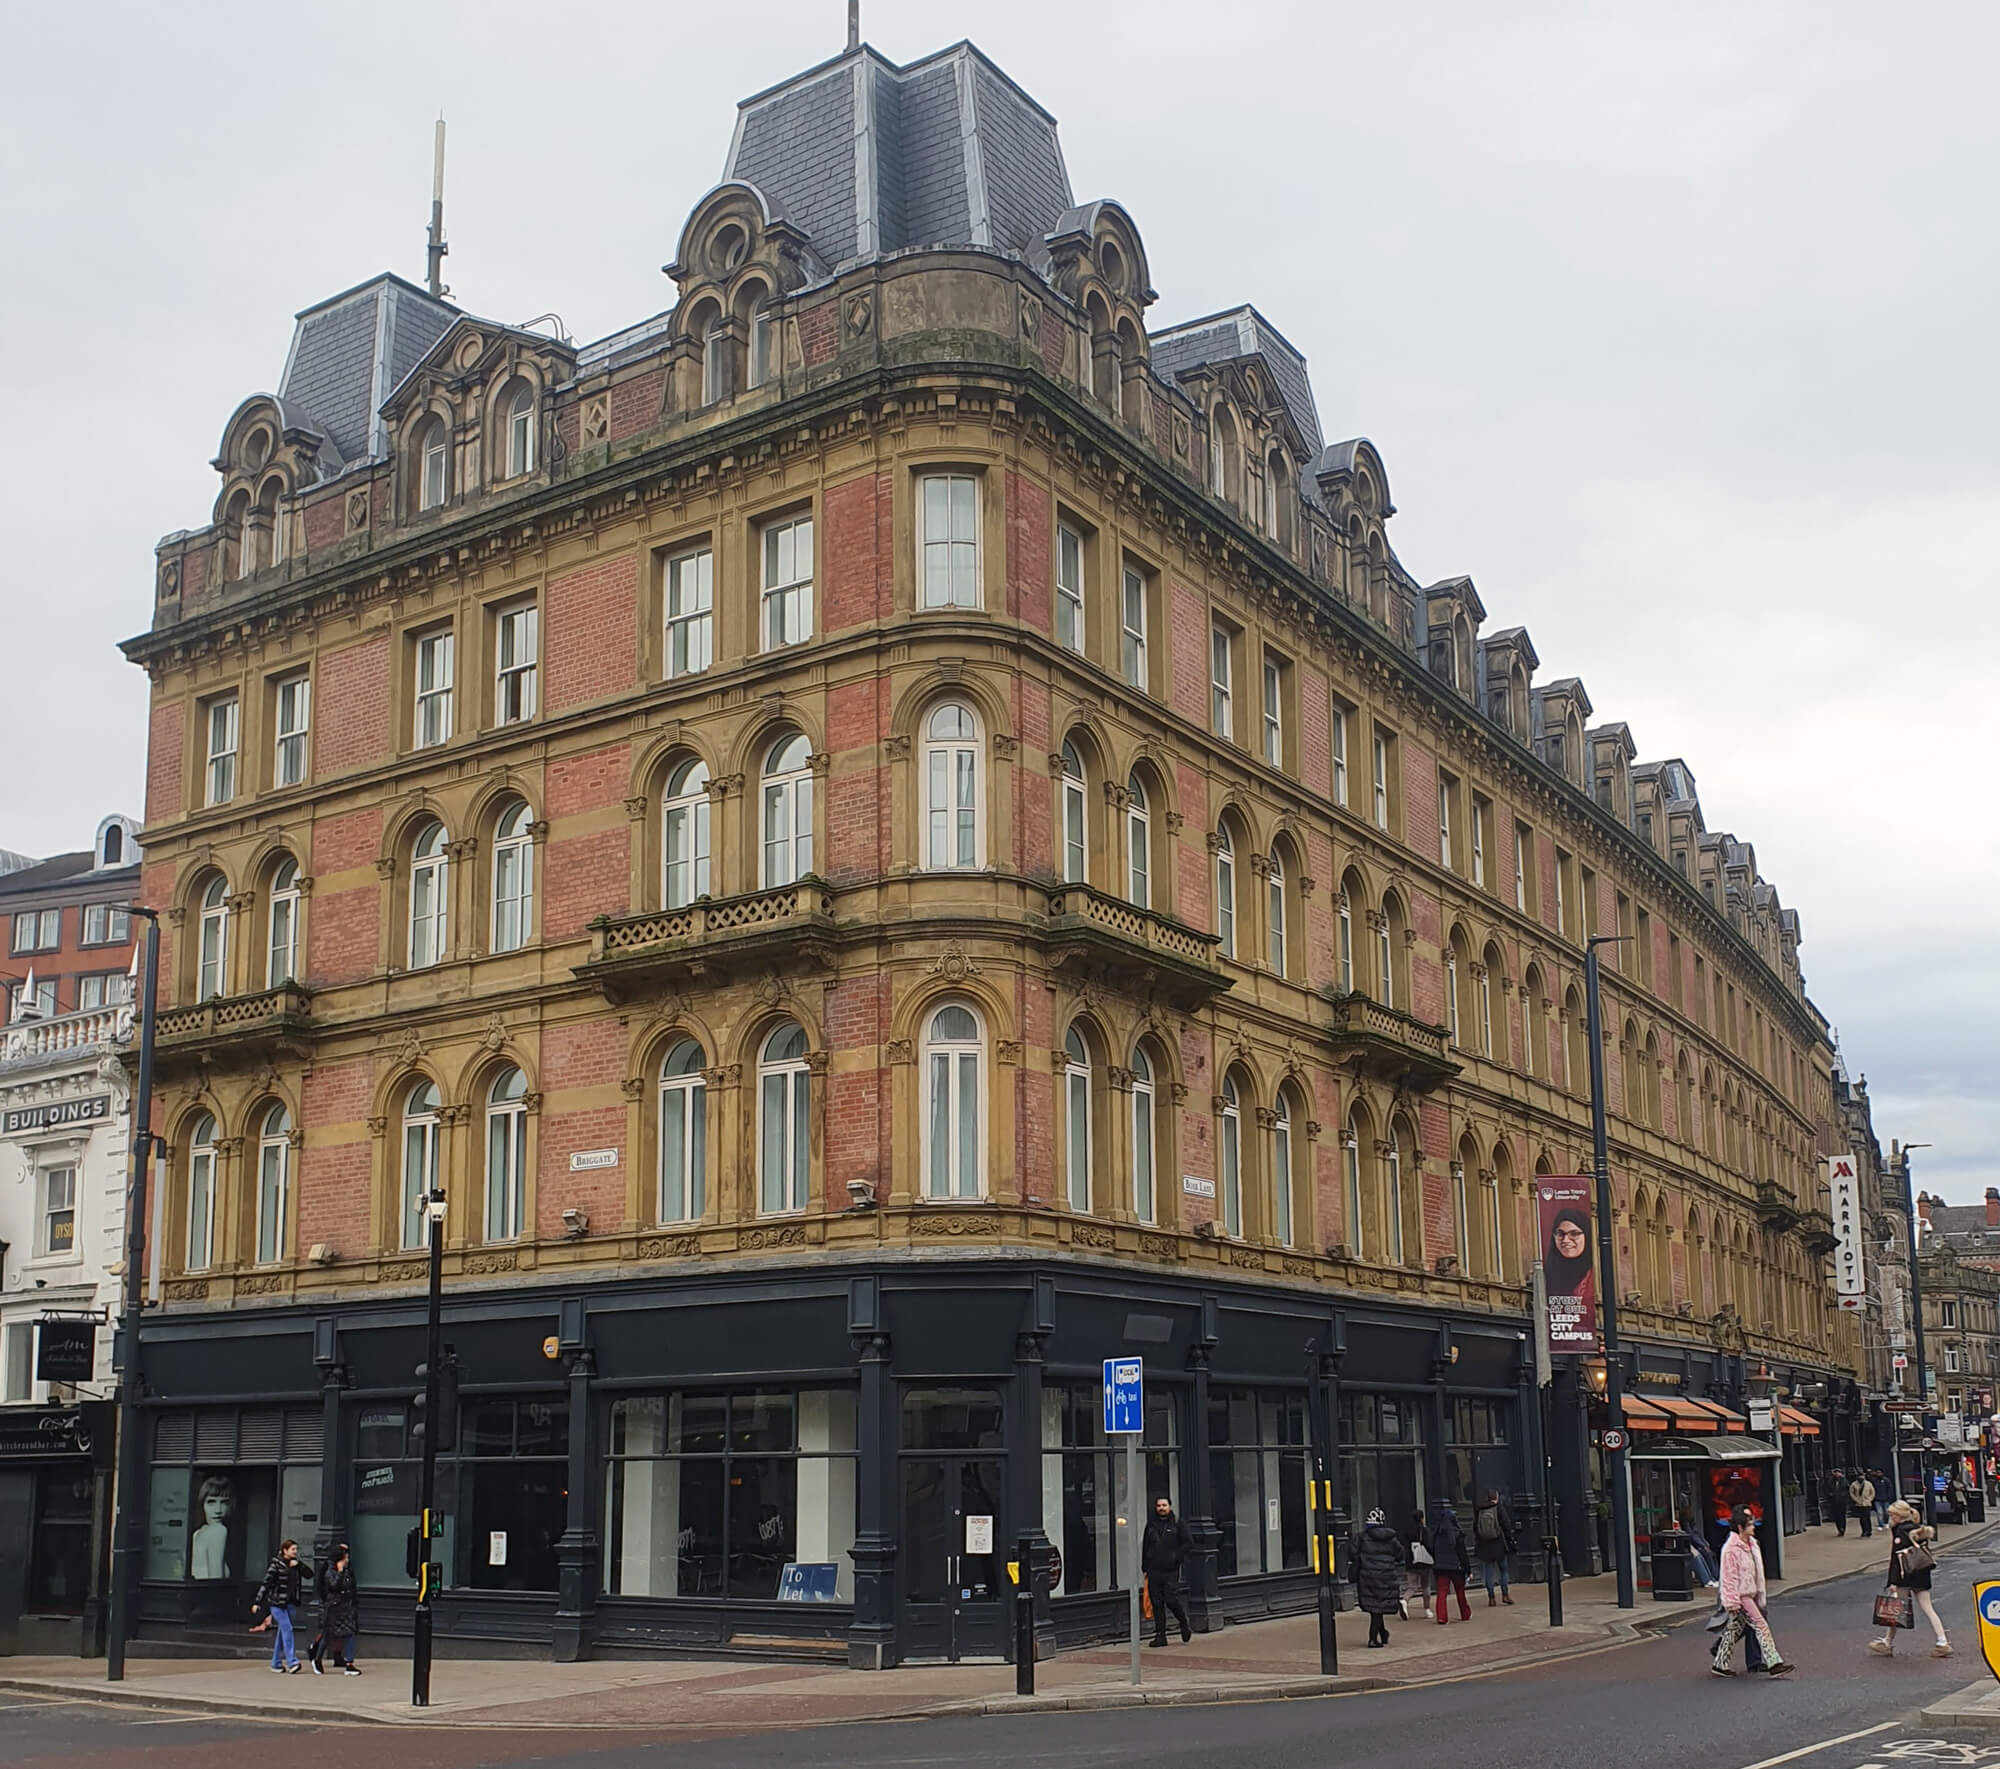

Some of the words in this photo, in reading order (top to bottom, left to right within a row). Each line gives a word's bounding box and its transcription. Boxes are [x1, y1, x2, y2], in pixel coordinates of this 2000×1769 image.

[9, 1100, 104, 1130] BUILDINGS
[1839, 1183, 1854, 1289] MARRIOTT
[1548, 1296, 1583, 1305] STUDY
[1549, 1304, 1564, 1314] AT
[1564, 1304, 1588, 1314] OUR
[1550, 1313, 1581, 1322] LEEDS
[1550, 1322, 1574, 1331] CITY
[1551, 1331, 1593, 1340] CAMPUS
[1606, 1435, 1620, 1444] 20
[787, 1567, 803, 1583] To
[783, 1585, 804, 1600] Let
